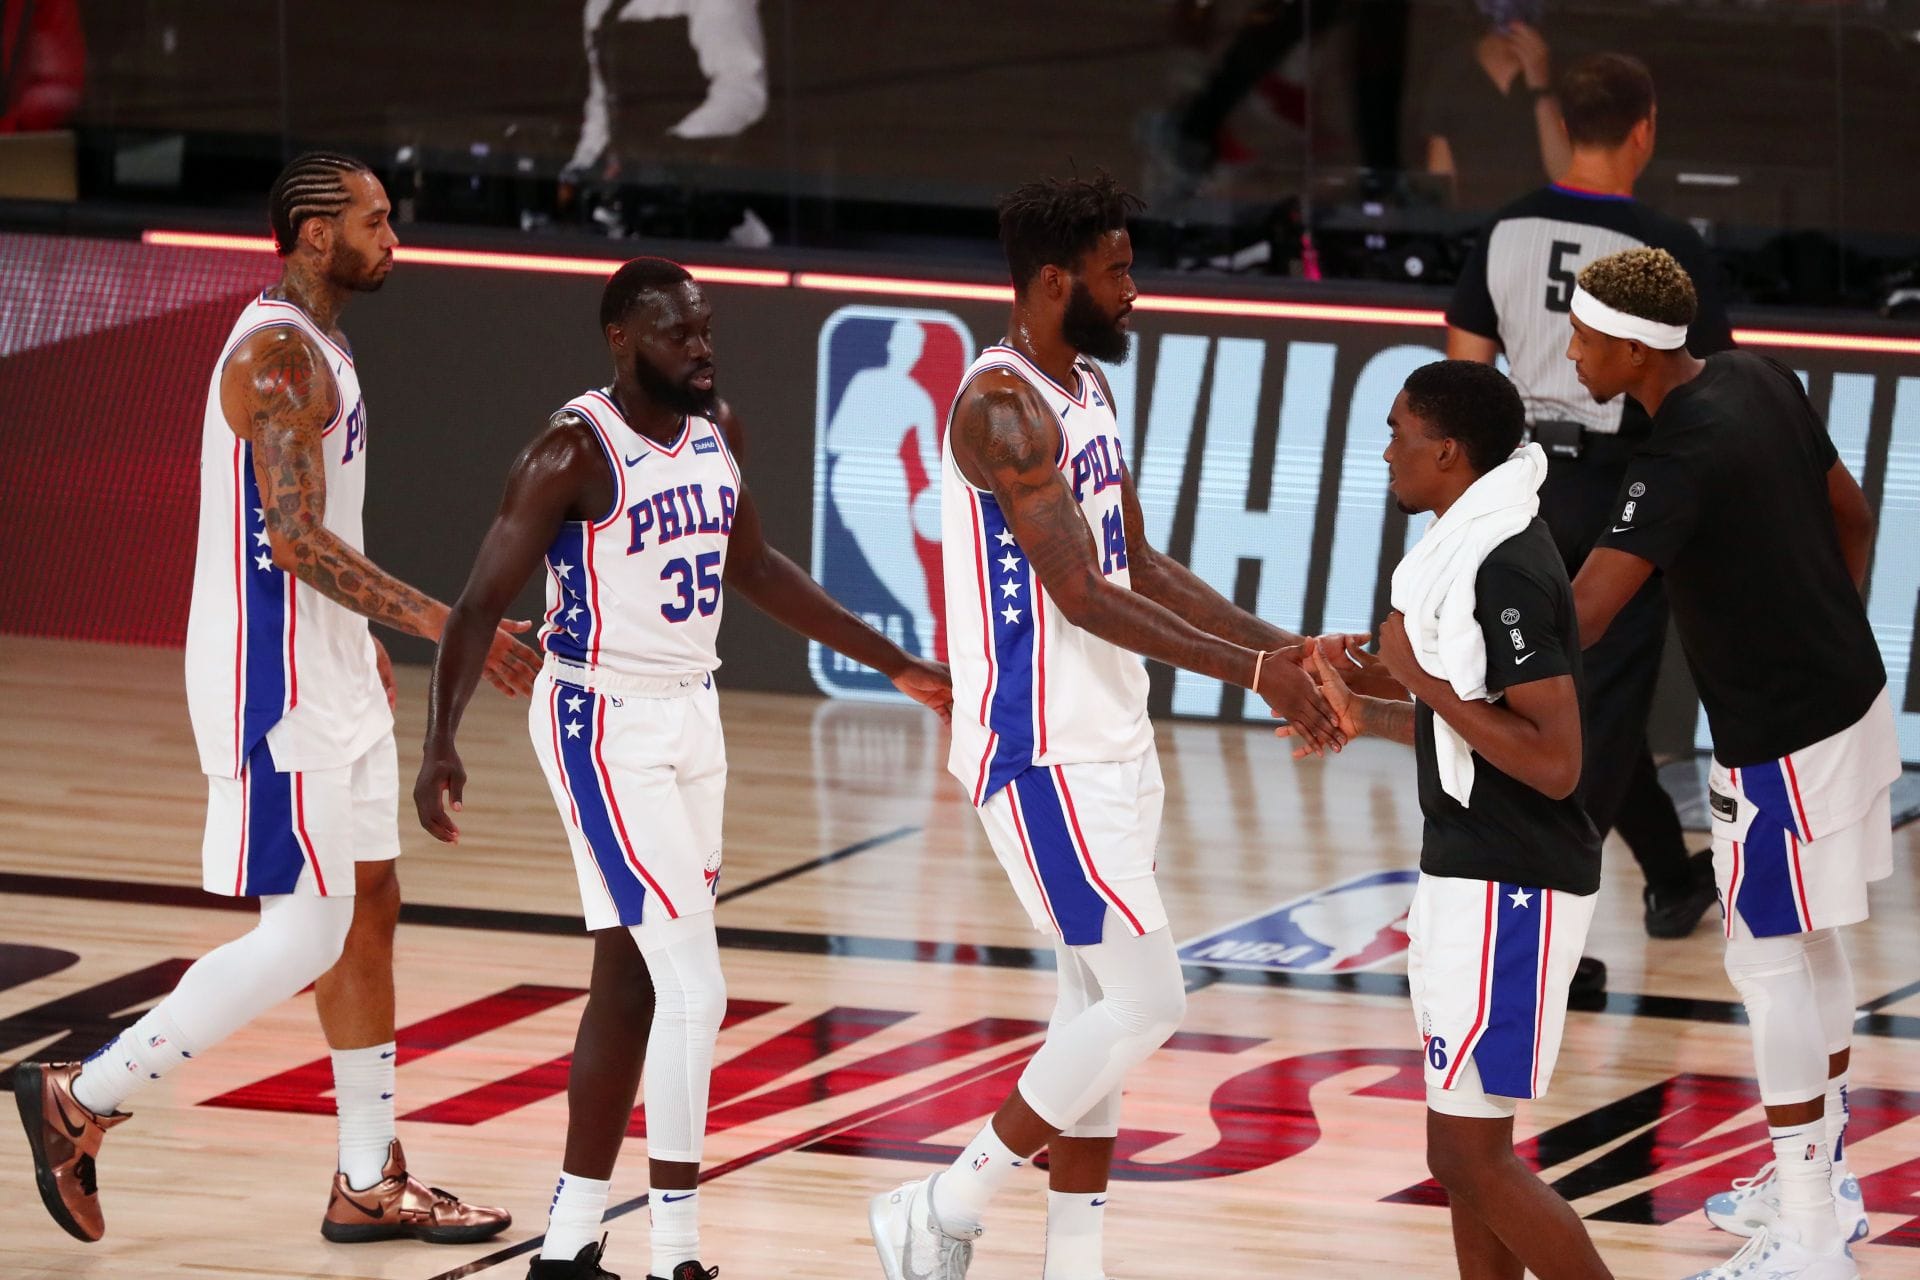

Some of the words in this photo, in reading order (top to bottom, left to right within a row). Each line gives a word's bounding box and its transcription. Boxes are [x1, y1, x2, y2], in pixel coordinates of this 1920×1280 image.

[1545, 240, 1581, 314] 5
[1101, 504, 1128, 576] 14
[660, 550, 721, 624] 35
[1192, 939, 1314, 965] NBA
